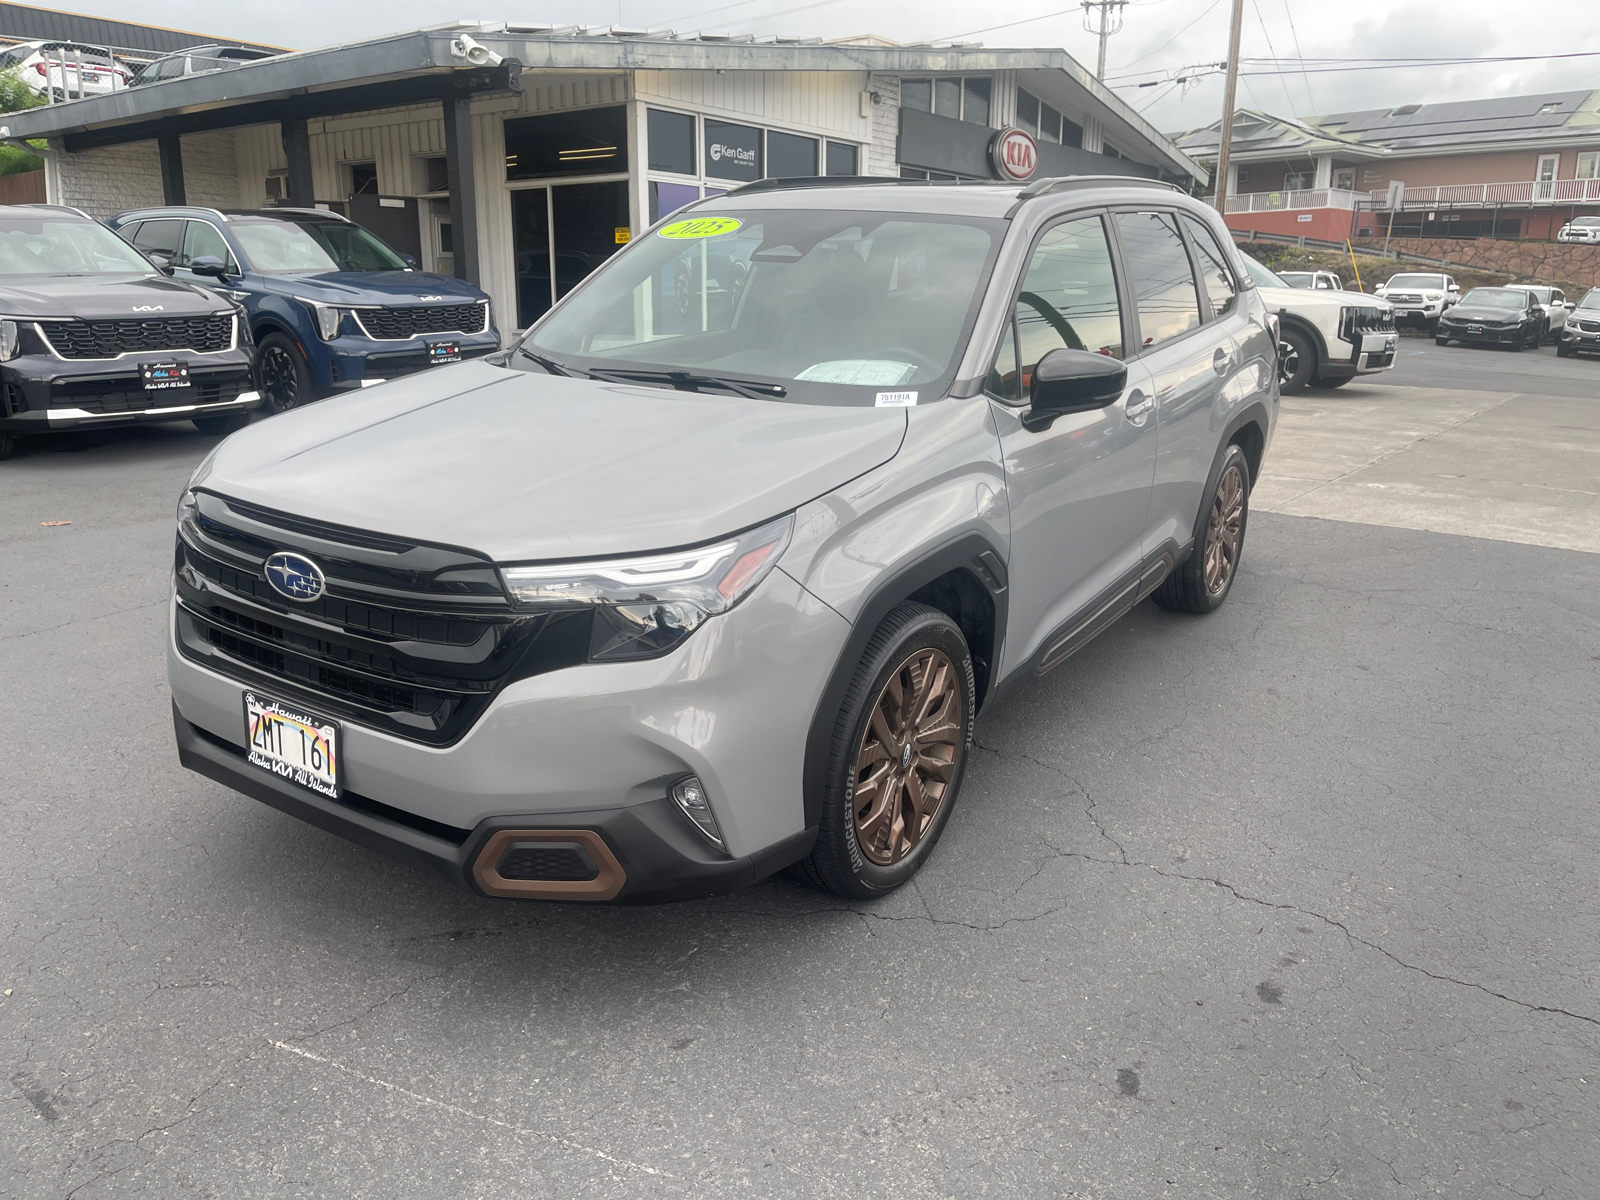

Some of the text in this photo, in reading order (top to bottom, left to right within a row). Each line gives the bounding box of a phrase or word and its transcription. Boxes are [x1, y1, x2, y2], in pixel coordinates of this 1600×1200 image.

[722, 145, 754, 160] Ken Garff
[1007, 141, 1032, 168] KIA
[666, 221, 733, 234] 2025
[266, 702, 312, 726] Hawaii
[250, 711, 331, 776] ZMT 161
[248, 751, 337, 799] Aloha KIA All Islands
